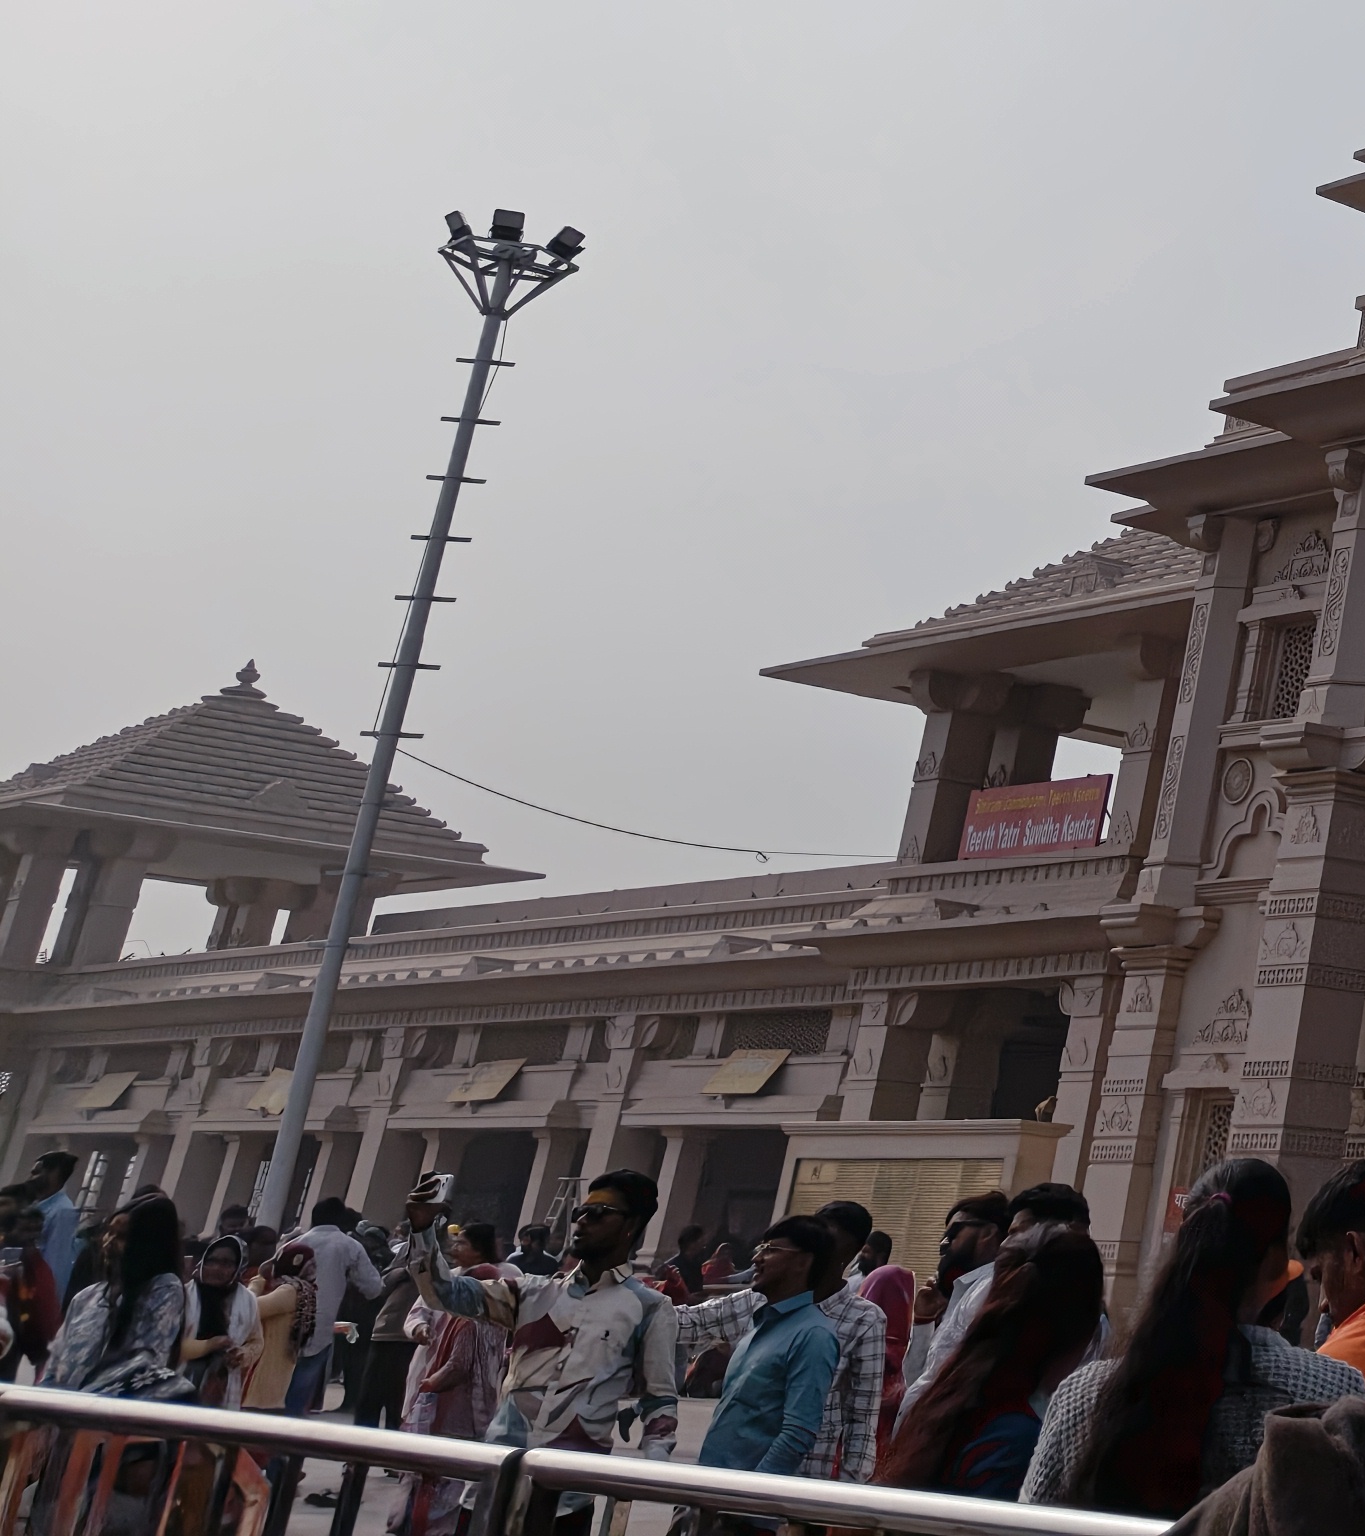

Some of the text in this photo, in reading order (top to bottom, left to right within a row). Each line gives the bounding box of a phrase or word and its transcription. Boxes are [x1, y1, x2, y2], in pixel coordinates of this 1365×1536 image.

[965, 813, 1096, 852] Teerth Yatri Suvidha Kendra
